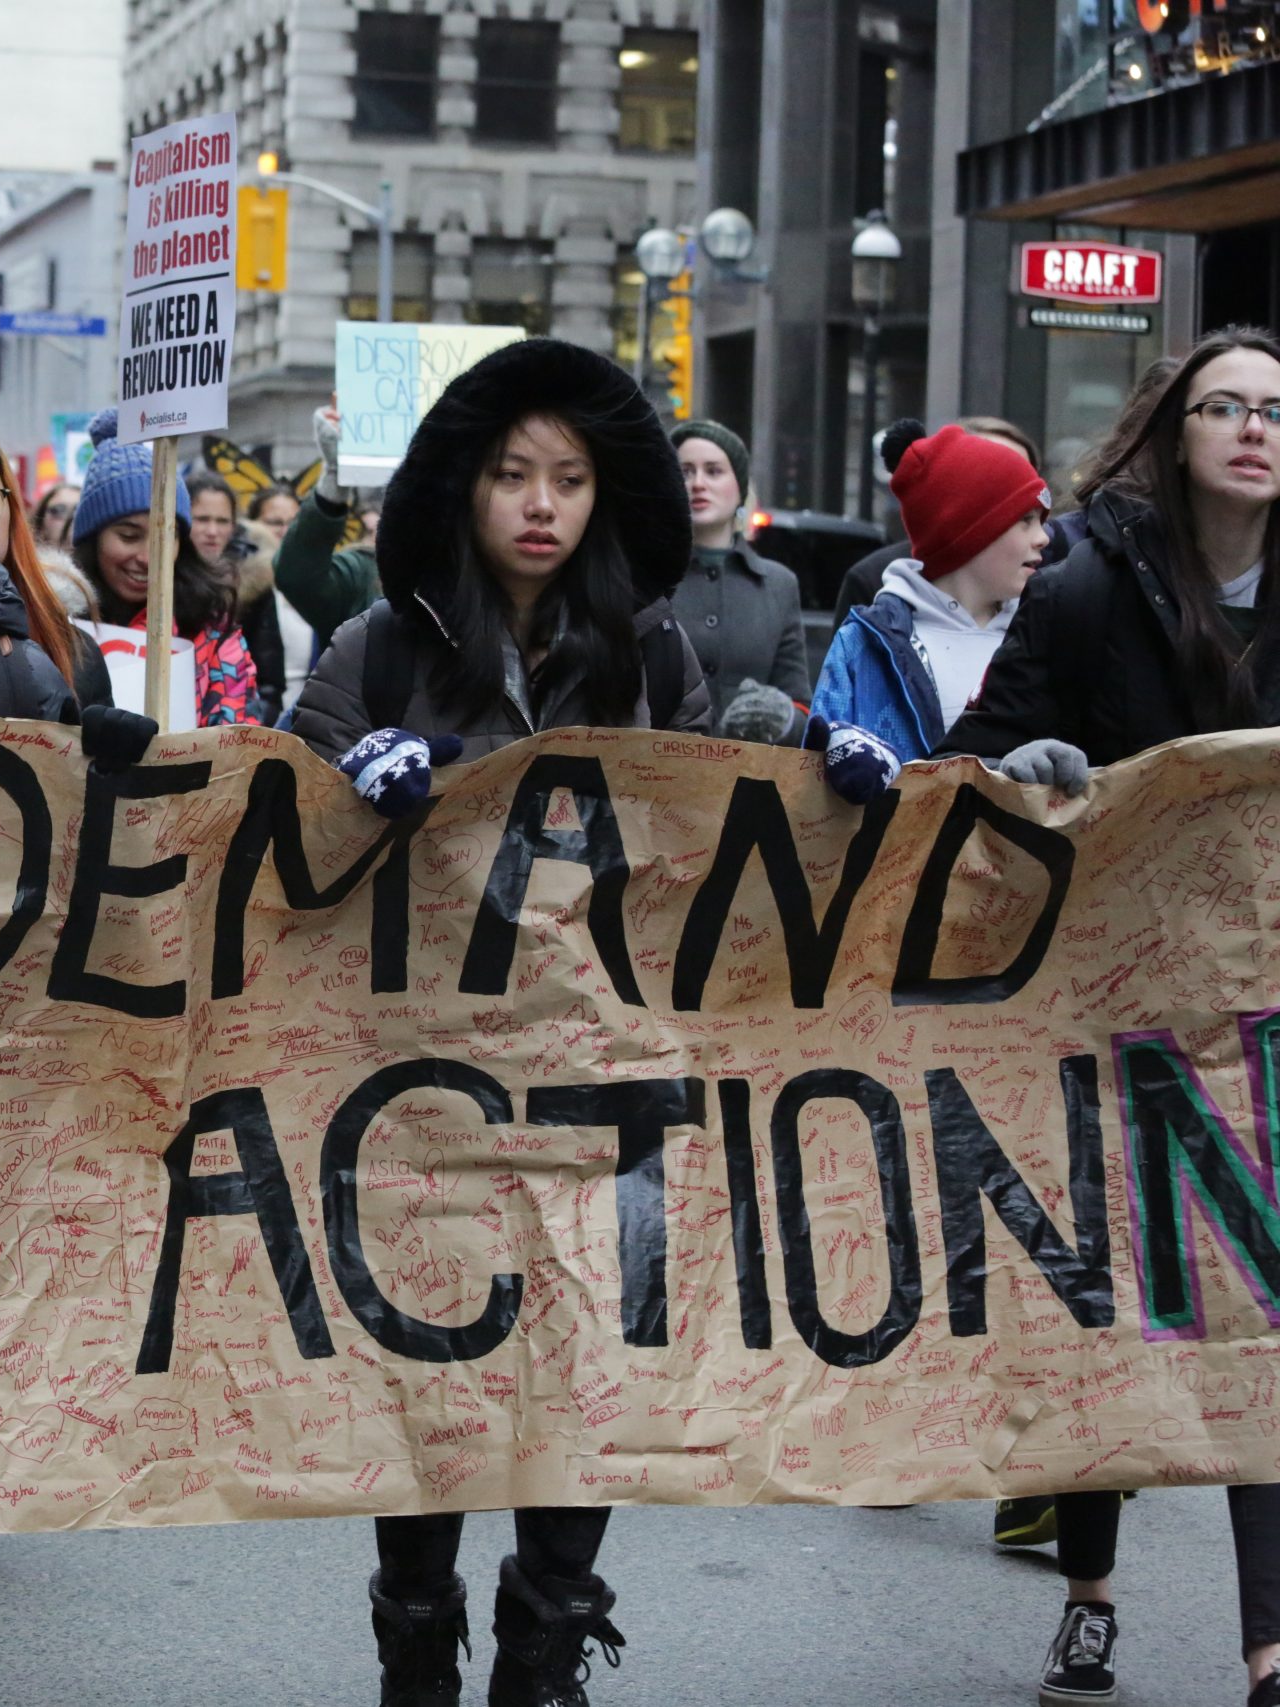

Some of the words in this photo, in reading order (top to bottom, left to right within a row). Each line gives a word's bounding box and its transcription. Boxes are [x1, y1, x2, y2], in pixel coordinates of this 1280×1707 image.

[134, 131, 231, 188] Capitalism
[147, 192, 162, 229] is
[164, 178, 229, 225] killing
[133, 240, 158, 279] the
[161, 224, 230, 275] planet
[1044, 249, 1139, 288] CRAFT
[131, 302, 153, 348] WE
[155, 293, 200, 342] NEED
[204, 290, 218, 335] A
[122, 339, 226, 401] REVOLUTION
[354, 335, 467, 377] DESTROY
[145, 411, 188, 427] socialist.ca
[339, 411, 387, 445] NOT
[136, 1057, 1117, 1375] ACTION
